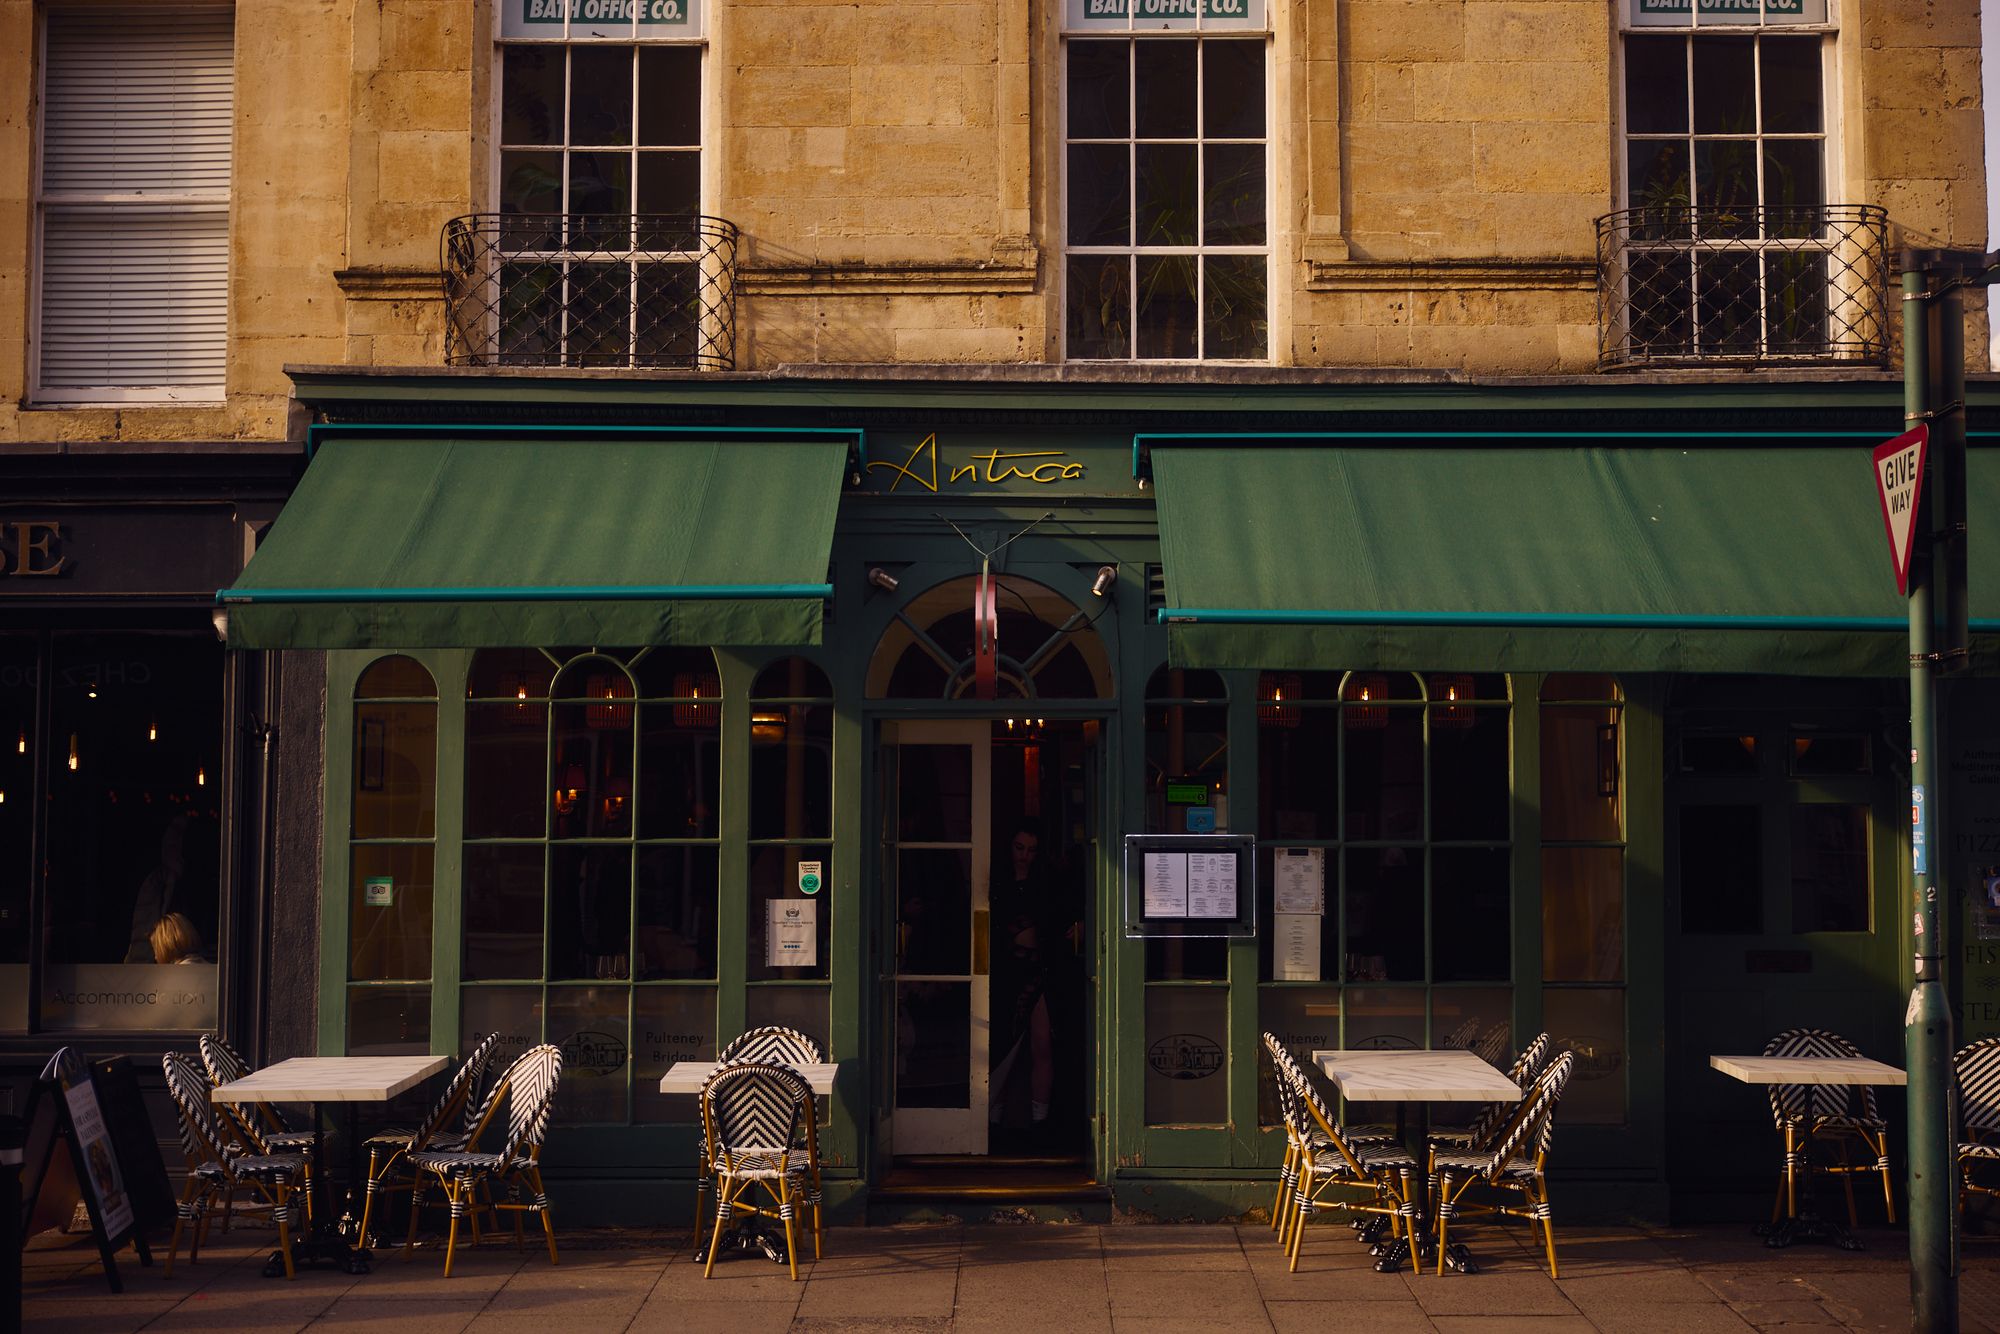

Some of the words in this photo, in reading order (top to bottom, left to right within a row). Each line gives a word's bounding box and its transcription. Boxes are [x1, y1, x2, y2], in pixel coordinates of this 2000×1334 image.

[529, 0, 580, 18] BATH
[584, 0, 647, 19] OFFICE
[651, 0, 682, 19] CO.
[866, 432, 1083, 492] Antica
[1885, 450, 1916, 491] GIVE
[1891, 488, 1911, 515] WAY
[0, 521, 66, 576] E
[1926, 886, 1937, 902] 2
[53, 989, 205, 1006] Accommodion
[645, 1031, 704, 1048] Pulteney
[1277, 1032, 1328, 1048] ulteney
[653, 1050, 697, 1063] Bridge
